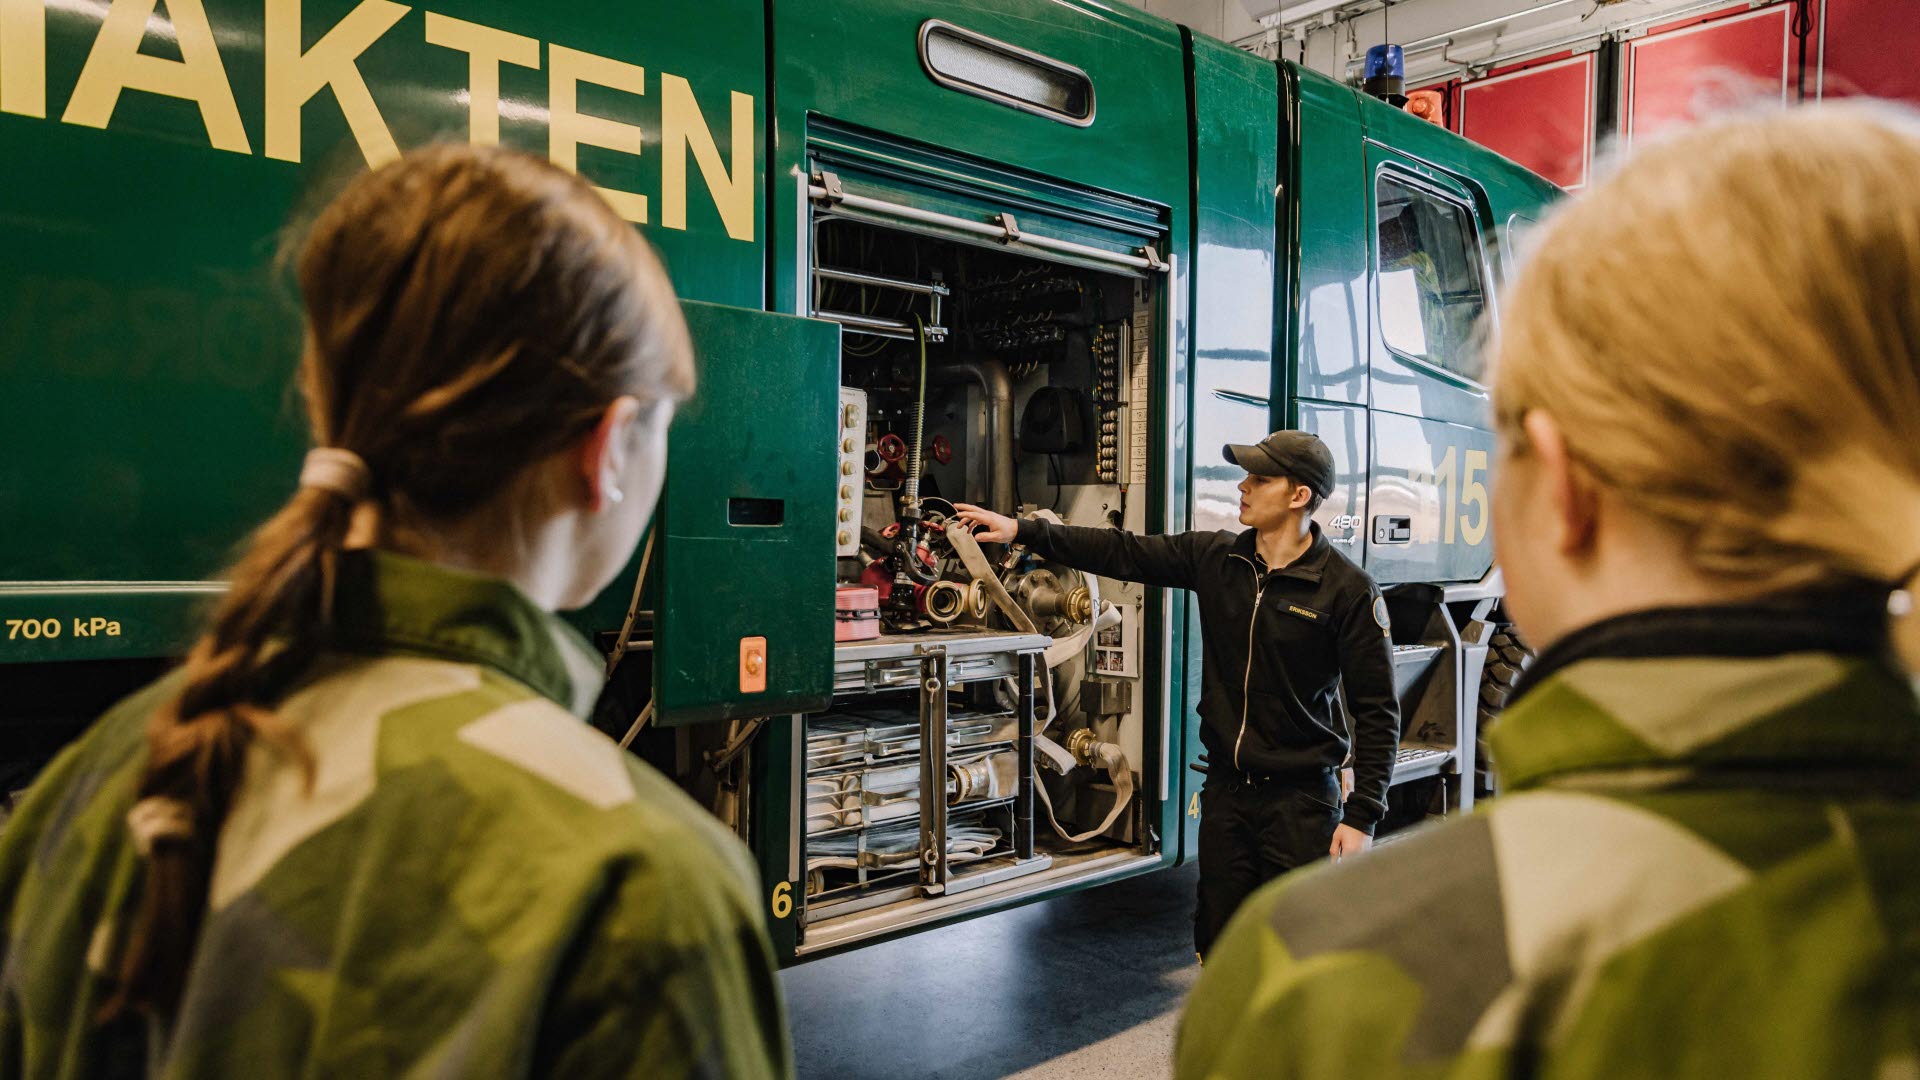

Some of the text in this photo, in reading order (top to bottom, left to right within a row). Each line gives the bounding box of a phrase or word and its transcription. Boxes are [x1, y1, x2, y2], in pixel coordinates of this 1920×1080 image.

[0, 0, 753, 242] AKTEN
[1328, 515, 1362, 529] 480
[1289, 605, 1317, 619] ERIKSSON
[6, 617, 121, 640] 700 kPa
[1187, 791, 1200, 819] 4
[772, 881, 792, 919] 6
